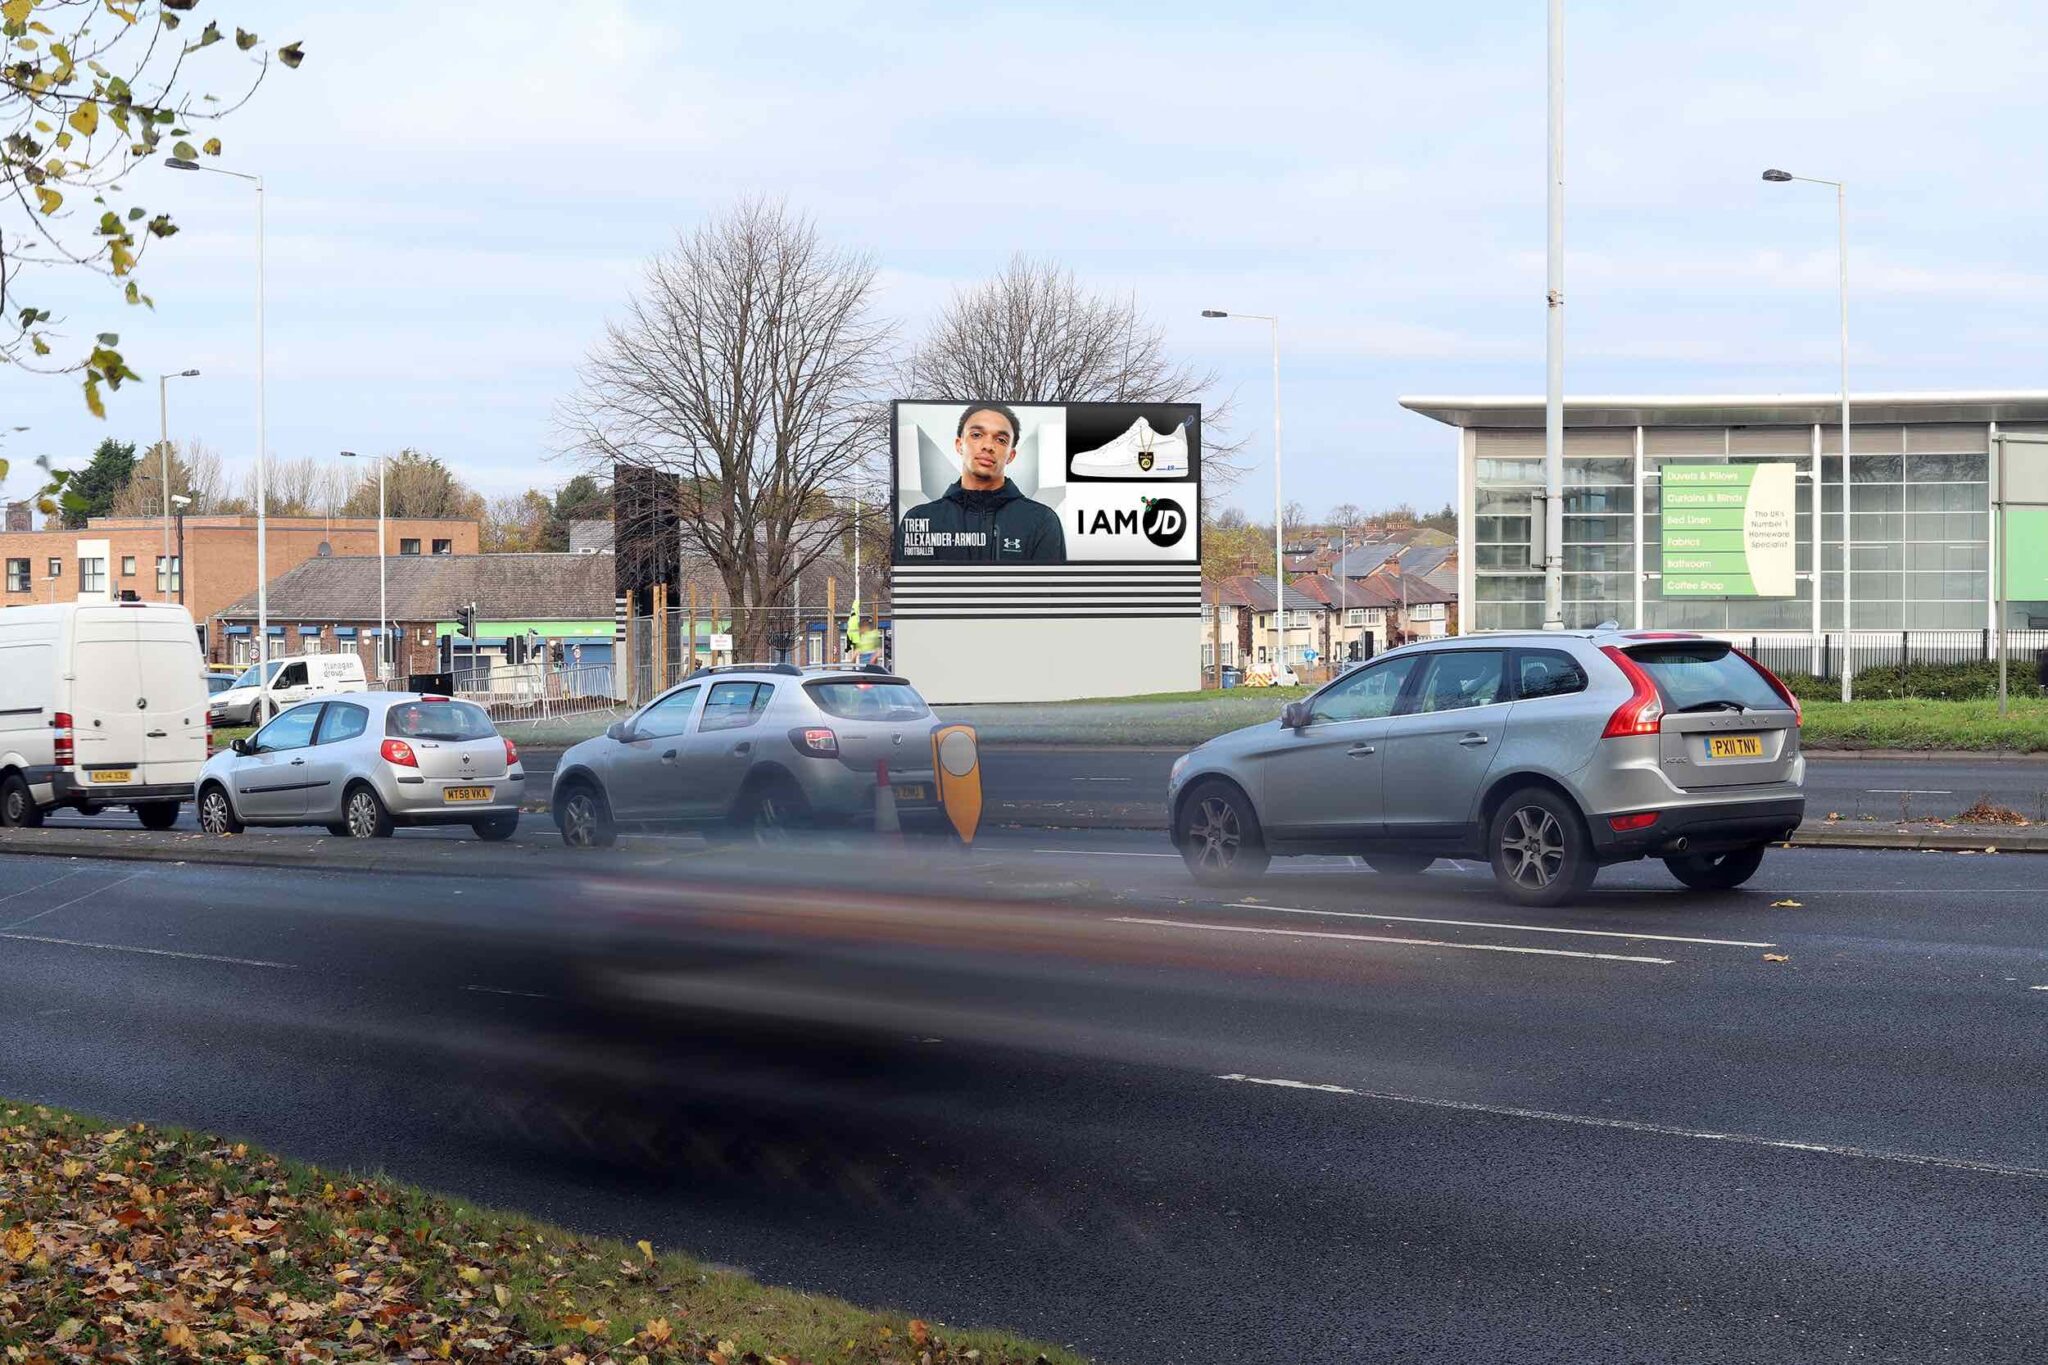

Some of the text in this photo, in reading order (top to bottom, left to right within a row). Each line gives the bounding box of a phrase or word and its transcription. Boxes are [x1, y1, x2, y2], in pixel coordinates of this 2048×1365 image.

[1667, 472, 1738, 480] Duvets & Pillows
[1667, 493, 1743, 503] Curtains & Blinds
[904, 518, 930, 532] TRENT
[1077, 509, 1182, 535] I AM JD
[1667, 516, 1712, 525] Bed Linen
[1751, 520, 1782, 528] Number
[904, 533, 987, 547] ALEXANDER-ARNOLD
[1667, 537, 1700, 547] Fabrics
[1751, 541, 1788, 550] Specialist
[904, 547, 934, 556] FOOTBALLER
[1667, 560, 1712, 569] Bathroom
[1667, 581, 1724, 591] Coffee Shop
[1738, 739, 1757, 753] TNV
[472, 789, 486, 798] VKA
